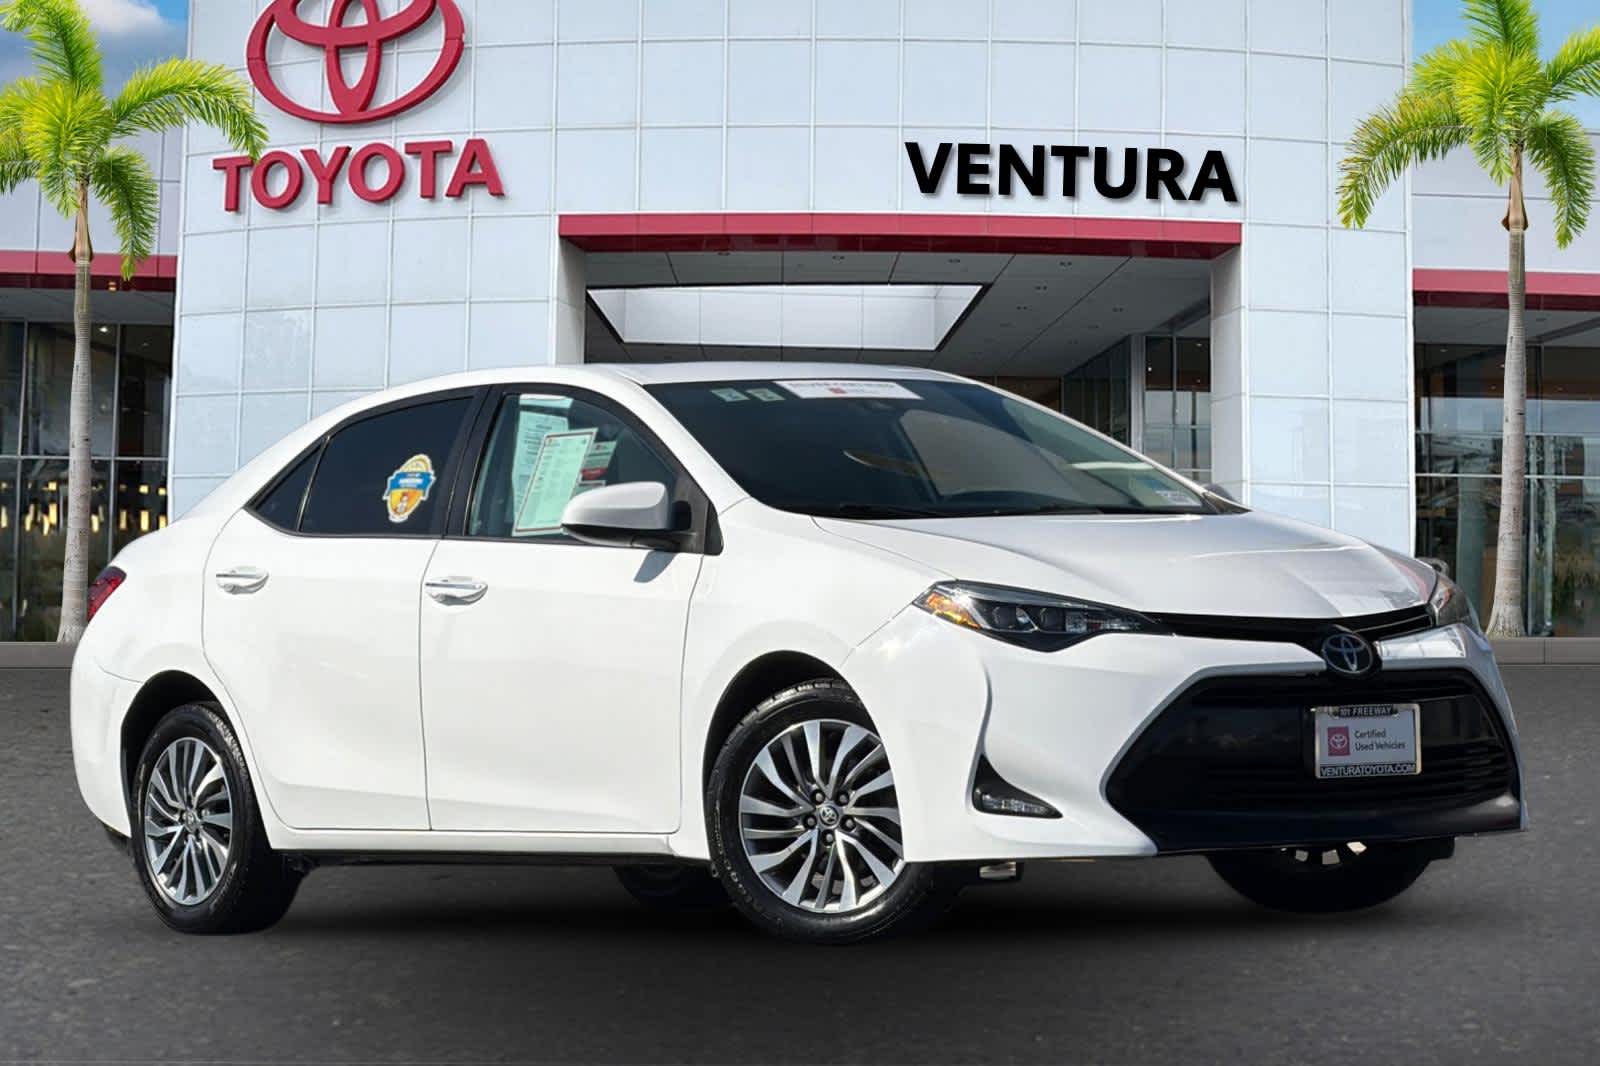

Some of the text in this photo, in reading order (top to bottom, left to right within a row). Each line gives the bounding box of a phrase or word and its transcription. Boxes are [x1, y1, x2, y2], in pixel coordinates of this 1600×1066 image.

[213, 138, 505, 212] TOYOTA
[904, 141, 1238, 202] VENTURA
[1352, 706, 1392, 716] FREEWAY
[1355, 728, 1386, 739] Certified
[1355, 741, 1406, 751] Used Vehicles
[1320, 763, 1416, 777] VENTURATOYOTA.COM
